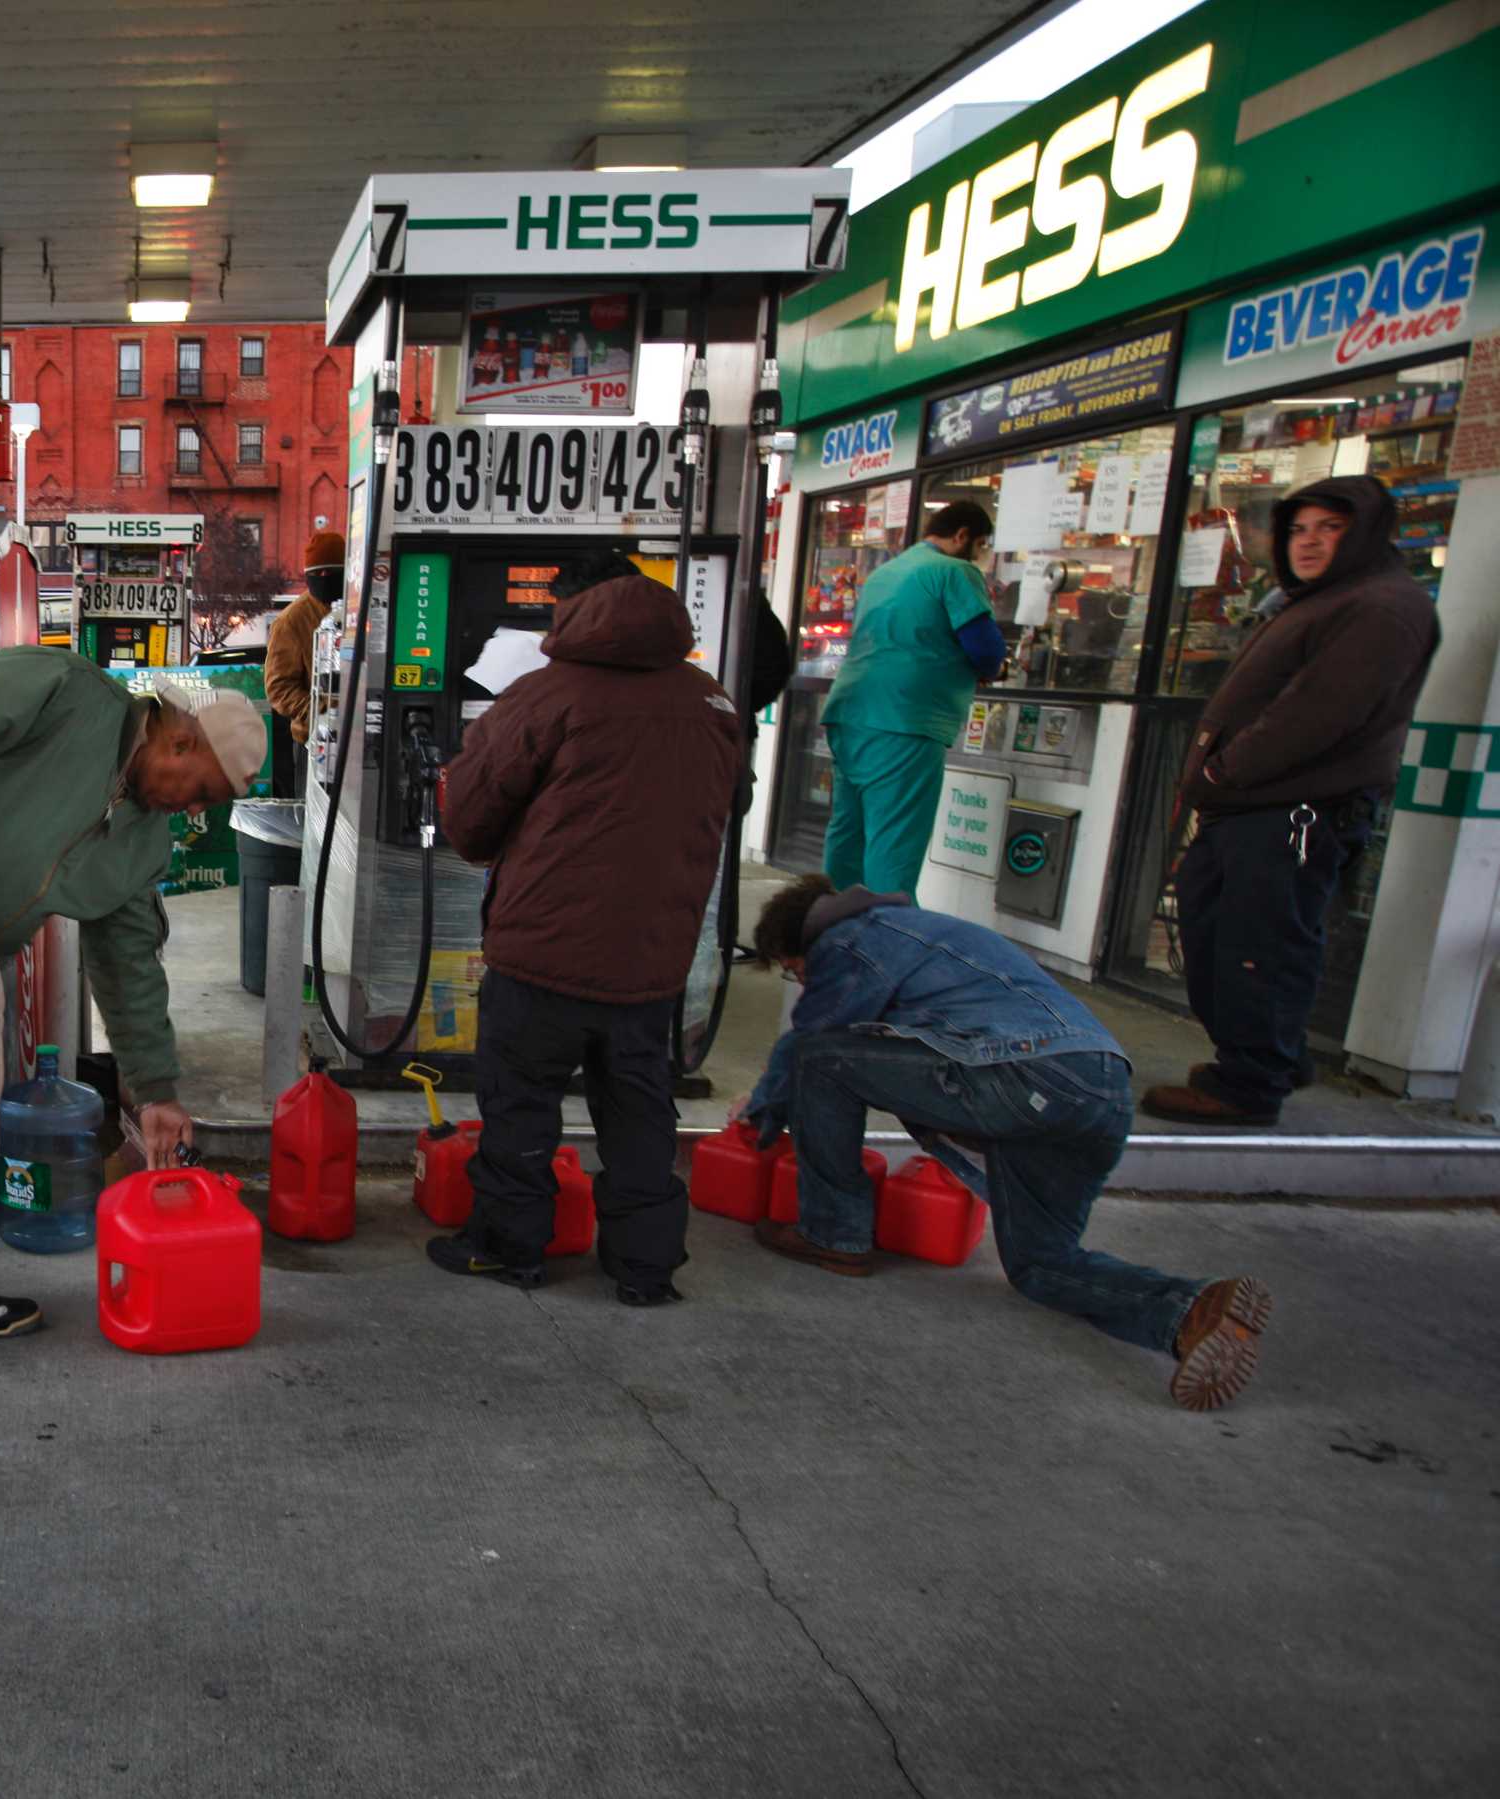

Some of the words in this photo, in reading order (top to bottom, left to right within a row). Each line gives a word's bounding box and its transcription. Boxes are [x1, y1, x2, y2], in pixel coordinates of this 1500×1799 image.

[895, 42, 1214, 354] HESS
[374, 203, 408, 270] 7
[516, 193, 699, 250] HESS
[812, 197, 848, 267] 7
[1226, 230, 1483, 362] BEVERAGE
[1335, 303, 1461, 365] Corner
[1014, 413, 1037, 430] SALE
[1077, 388, 1136, 415] NOVEMBER
[822, 411, 897, 466] SNACK
[849, 451, 890, 478] Corner
[67, 522, 77, 541] 8
[108, 521, 162, 537] HESS
[193, 523, 203, 543] 8
[415, 564, 431, 641] REGULAR
[948, 810, 961, 828] for
[963, 816, 988, 833] your
[951, 787, 988, 809] Thanks
[943, 832, 988, 857] business
